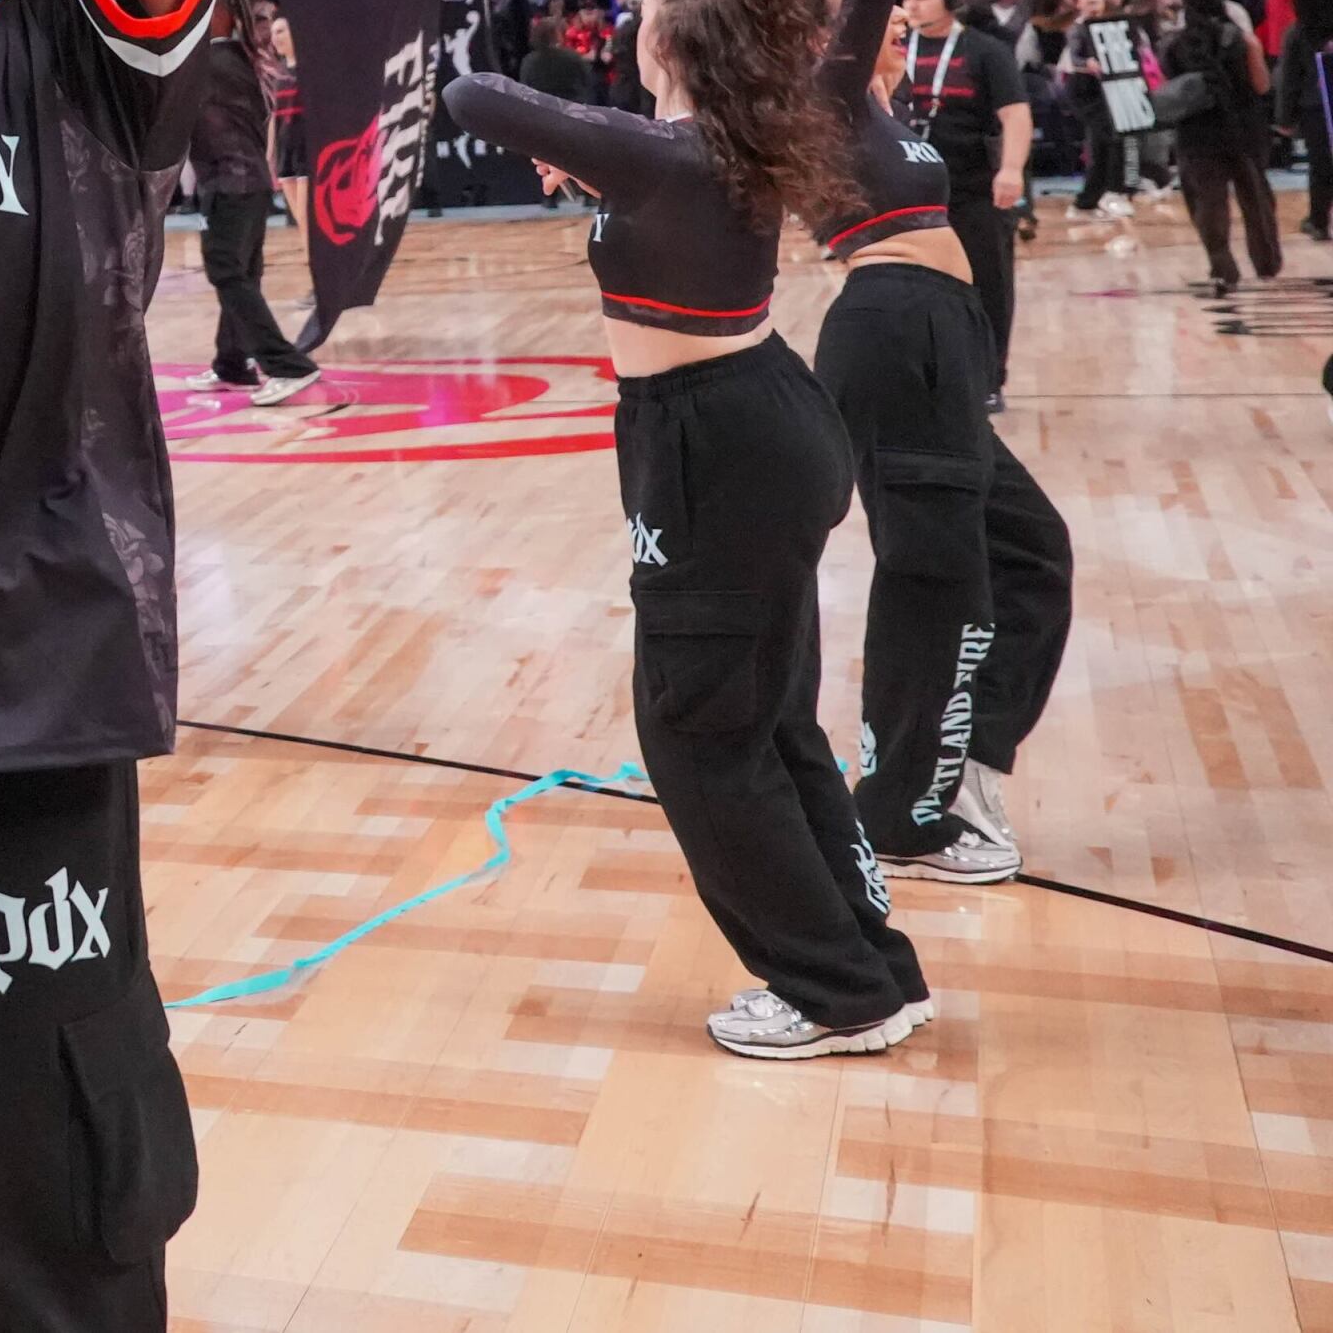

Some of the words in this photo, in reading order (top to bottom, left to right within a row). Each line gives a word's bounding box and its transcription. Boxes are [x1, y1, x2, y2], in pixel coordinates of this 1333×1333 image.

[1084, 20, 1139, 75] FIRE
[1101, 77, 1156, 133] WINS
[897, 140, 945, 164] RO
